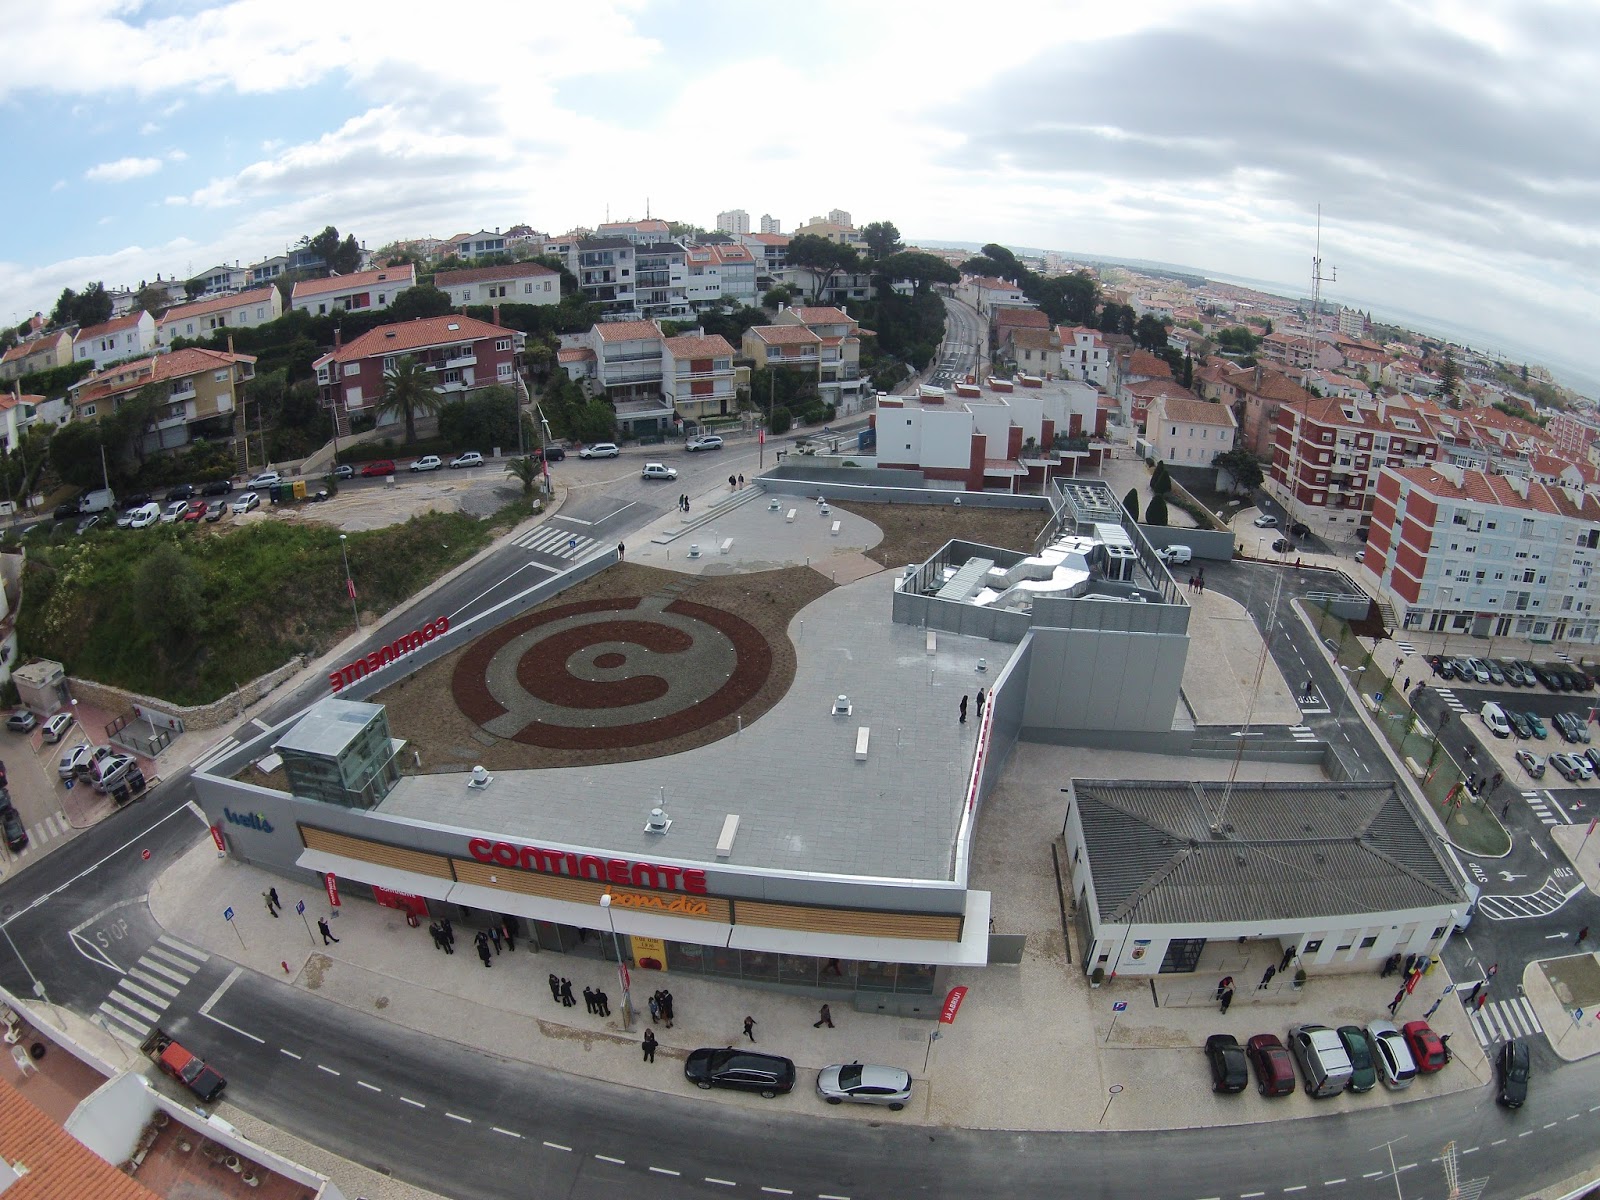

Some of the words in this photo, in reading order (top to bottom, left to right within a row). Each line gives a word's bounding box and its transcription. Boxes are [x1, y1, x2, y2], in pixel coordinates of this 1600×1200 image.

[468, 837, 708, 895] CONTINENTE
[1468, 862, 1488, 883] STOP
[1553, 866, 1574, 878] STOP
[96, 918, 128, 948] STOP
